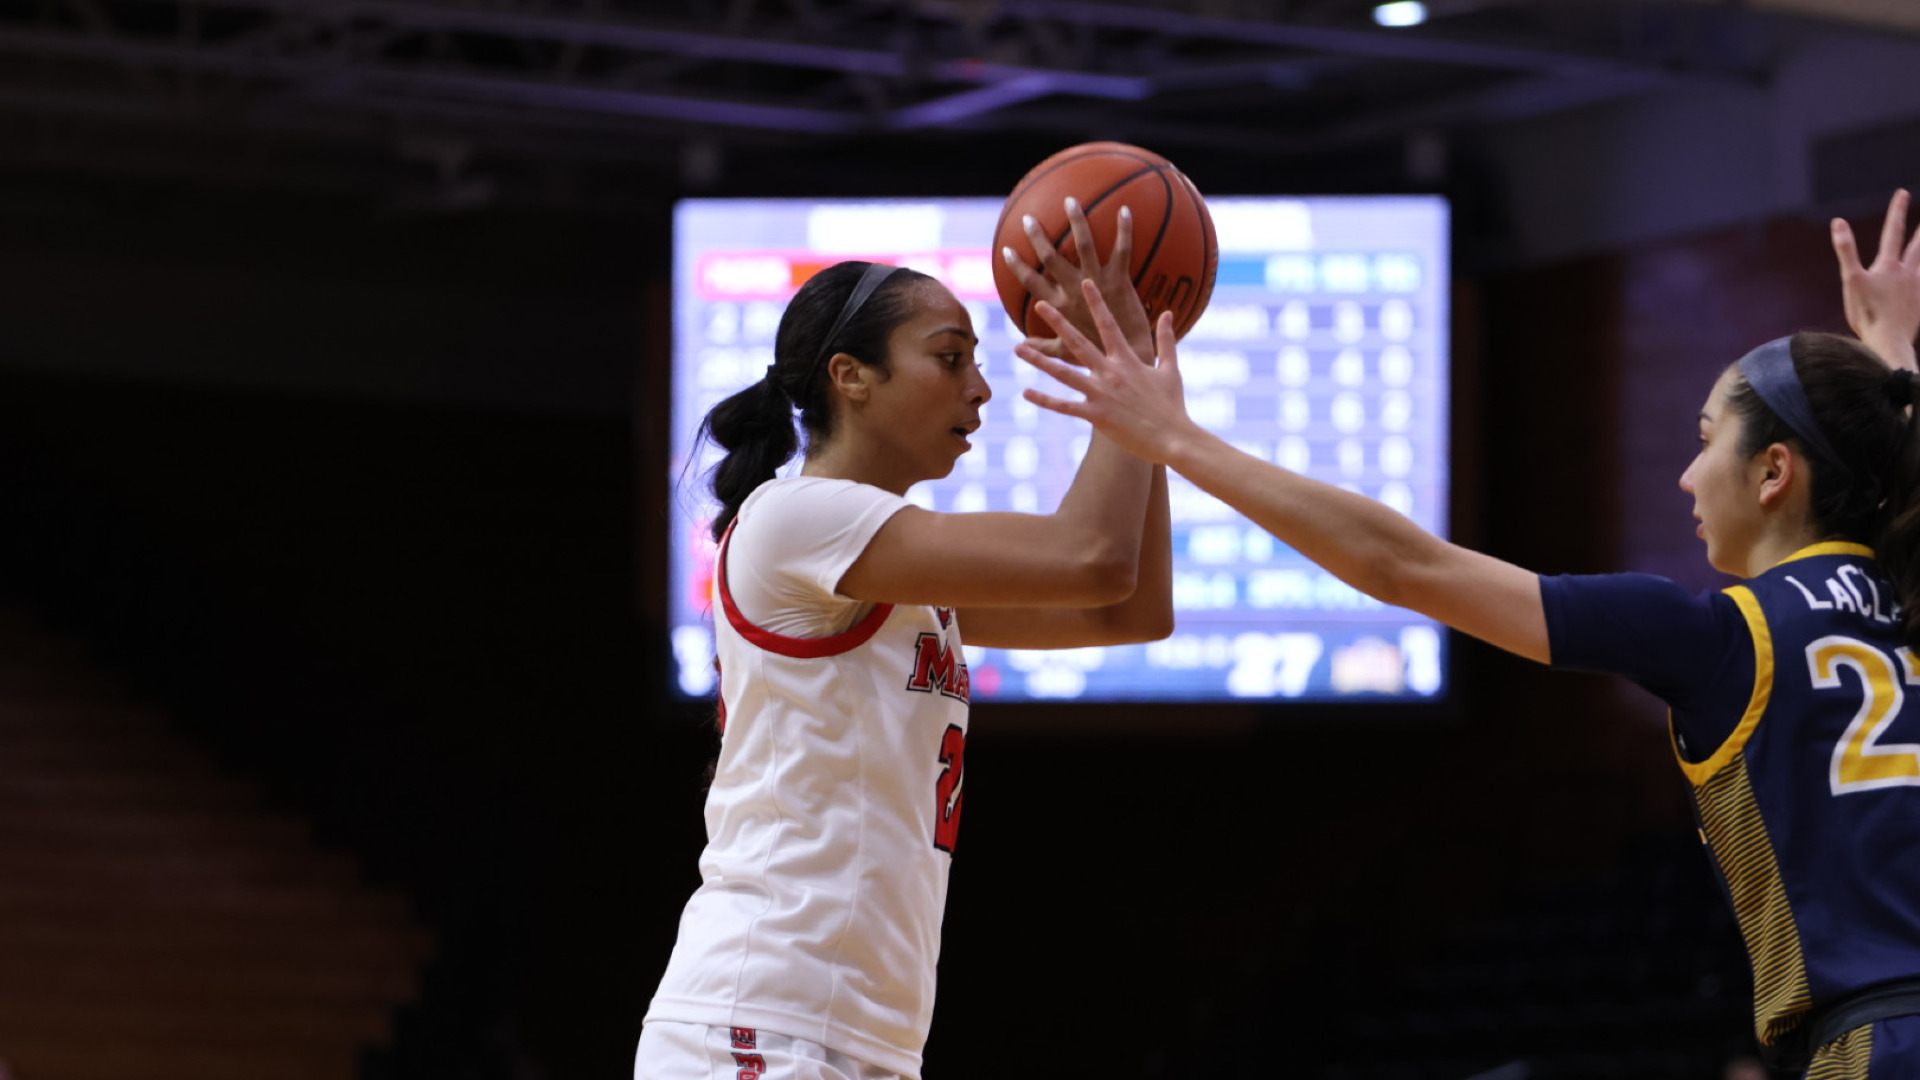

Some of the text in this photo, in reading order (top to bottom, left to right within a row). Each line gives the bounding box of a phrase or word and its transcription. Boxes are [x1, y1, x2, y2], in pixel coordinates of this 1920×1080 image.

[1784, 563, 1902, 624] LACL
[1804, 635, 1920, 797] 2
[934, 722, 967, 856] 2
